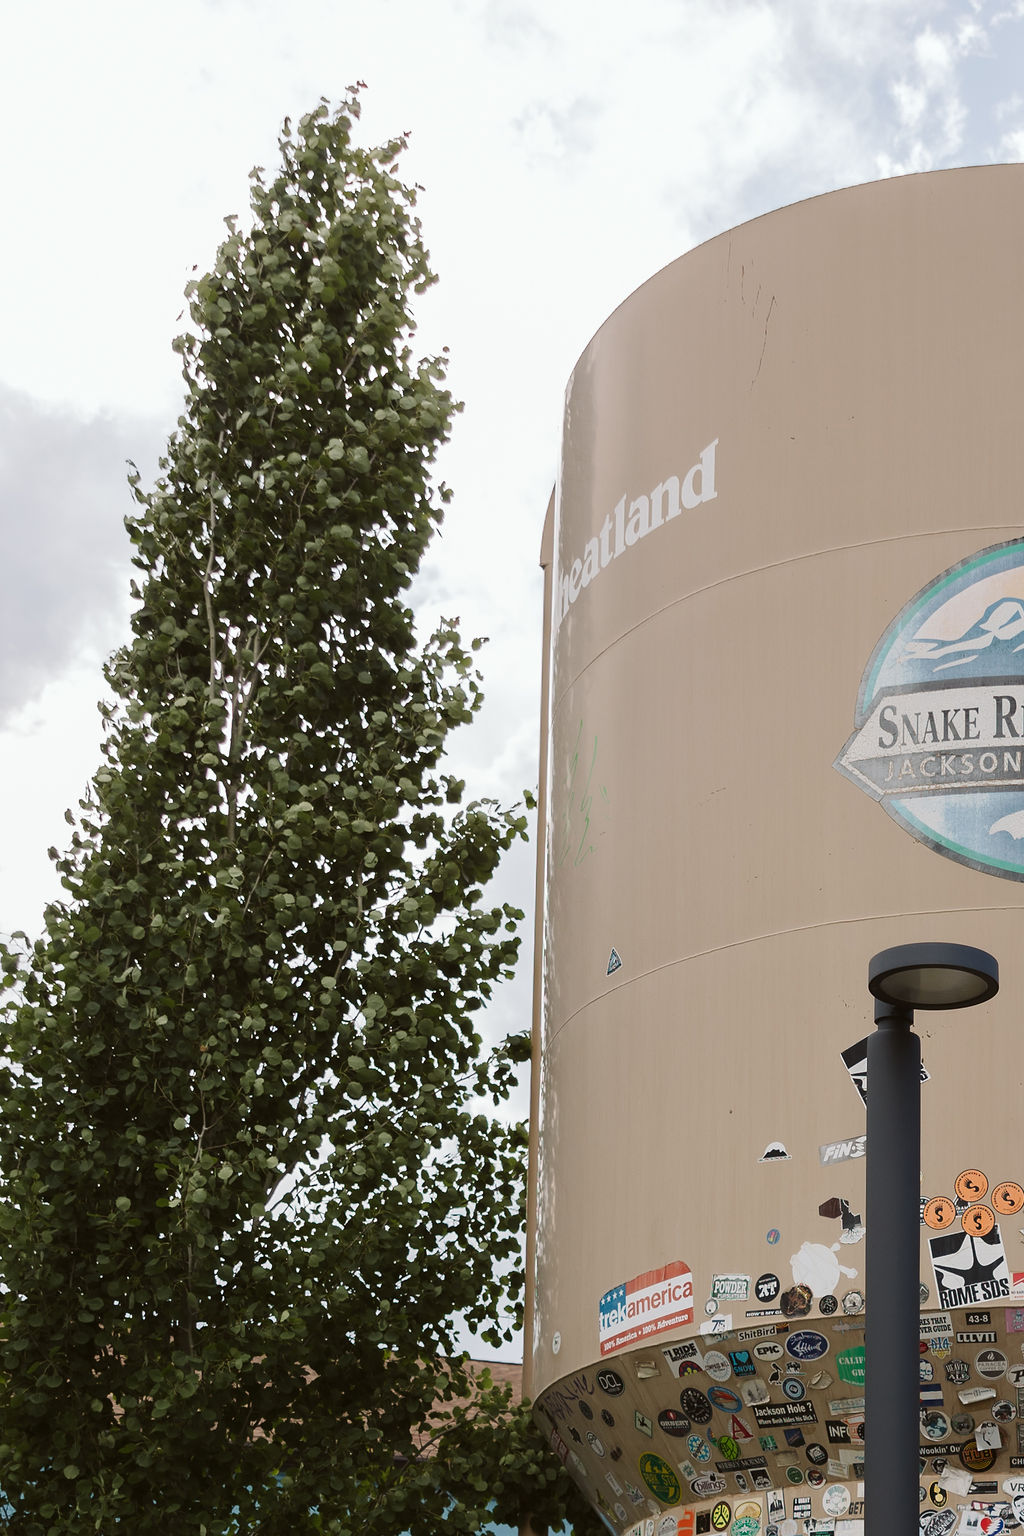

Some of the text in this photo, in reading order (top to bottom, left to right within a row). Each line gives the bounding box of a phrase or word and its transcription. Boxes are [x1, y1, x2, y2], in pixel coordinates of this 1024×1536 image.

[555, 438, 718, 627] heatland
[878, 704, 981, 749] SNAKE
[884, 751, 1022, 782] JACKSON
[714, 1281, 747, 1294] POWDER
[940, 1284, 981, 1309] ROME
[982, 1278, 1010, 1300] SDS
[932, 1316, 947, 1325] THAT
[968, 1314, 989, 1323] 43-8
[739, 1326, 776, 1341] ShitBird
[932, 1324, 951, 1334] GUIDE
[674, 1343, 696, 1359] RIDE
[757, 1345, 780, 1355] EPIC
[734, 1365, 754, 1373] SNOW
[599, 1375, 621, 1390] DCL
[755, 1406, 786, 1417] Jackson
[787, 1404, 806, 1414] Hole
[732, 1414, 753, 1440] A
[696, 1477, 726, 1490] billings
